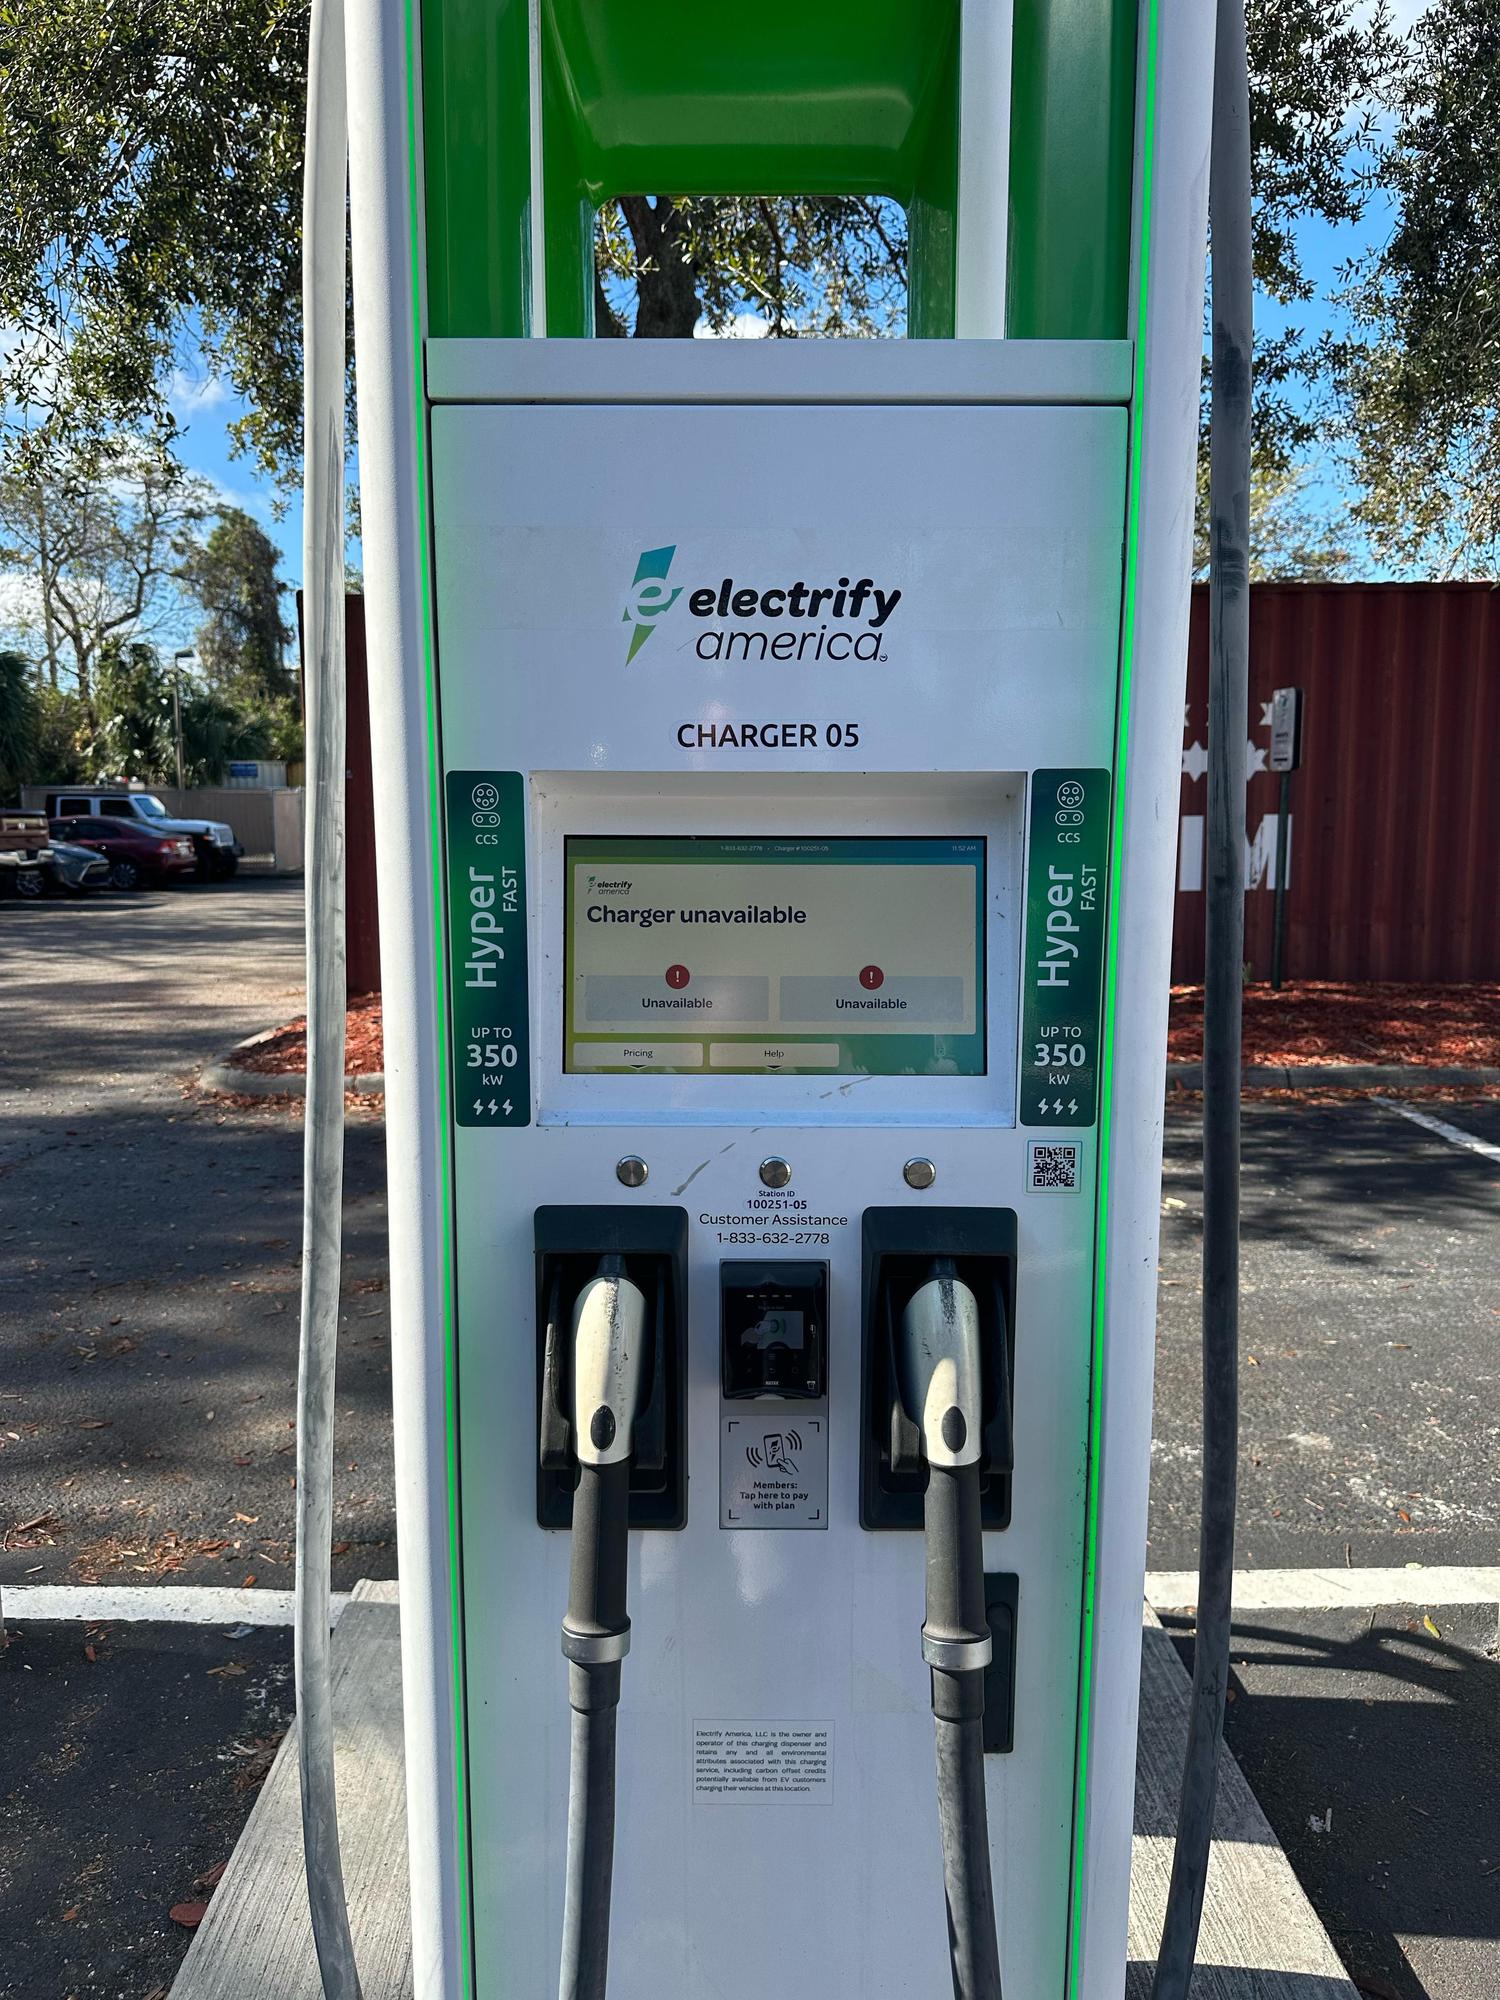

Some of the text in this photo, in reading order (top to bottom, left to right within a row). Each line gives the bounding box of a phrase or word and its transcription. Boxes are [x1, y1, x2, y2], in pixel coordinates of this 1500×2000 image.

[689, 577, 902, 628] electrify
[695, 624, 884, 662] america
[677, 723, 860, 748] CHARGER 05
[475, 834, 499, 845] CCS
[1057, 832, 1081, 843] CCS
[502, 866, 518, 912] FAST
[597, 881, 633, 890] electrify
[1080, 864, 1097, 911] FAST
[587, 905, 807, 928] Charger unavailable
[465, 866, 505, 988] Hyper
[1037, 865, 1080, 987] Hyper
[641, 998, 713, 1009] Unavailable
[835, 998, 907, 1010] Unavailable
[471, 1027, 513, 1039] UP TO
[1040, 1026, 1081, 1038] UP TO
[466, 1044, 518, 1068] 350
[623, 1049, 653, 1059] Pricing
[764, 1049, 785, 1060] Help
[1034, 1043, 1086, 1067] 350
[482, 1073, 504, 1086] kW
[1049, 1073, 1070, 1085] kW
[758, 1190, 796, 1198] Station ID
[746, 1199, 808, 1210] 100251-05
[699, 1213, 848, 1226] Customer Assistance
[716, 1232, 830, 1244] 1-833-632-2778
[753, 1481, 798, 1489] Members:
[740, 1491, 809, 1501] Tap here to pay
[753, 1501, 796, 1511] with plan
